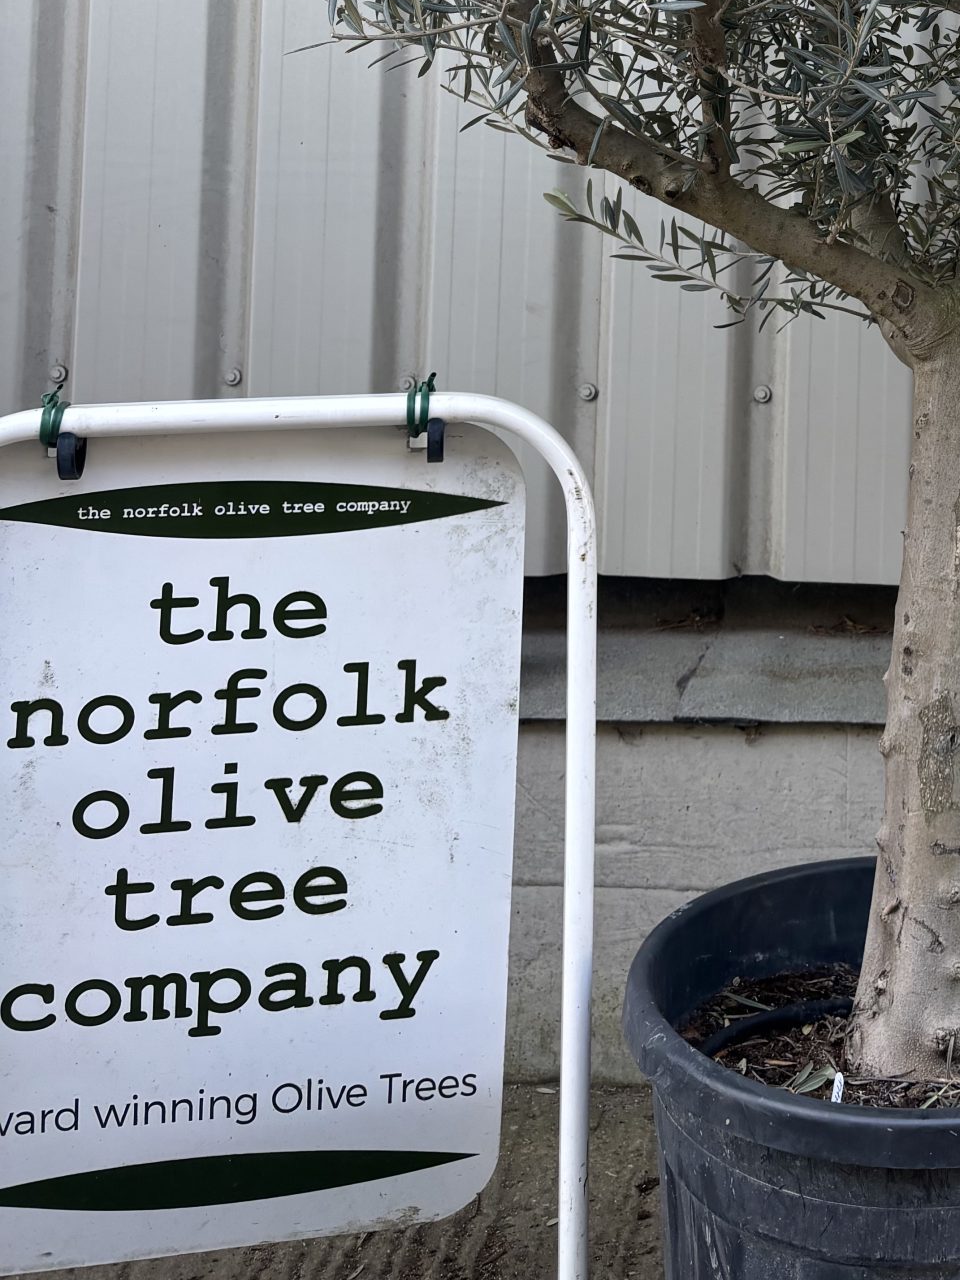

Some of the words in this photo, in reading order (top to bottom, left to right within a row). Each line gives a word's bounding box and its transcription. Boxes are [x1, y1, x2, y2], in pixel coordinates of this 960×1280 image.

[77, 503, 111, 520] the
[123, 503, 203, 519] norfolk
[214, 502, 270, 516] olive
[281, 502, 325, 514] tree
[335, 500, 412, 515] company
[150, 576, 328, 646] the
[7, 659, 450, 749] norfolk
[71, 762, 384, 840] olive
[105, 866, 348, 932] tree
[0, 949, 440, 1038] company
[93, 1089, 258, 1129] winning
[271, 1078, 368, 1114] Olive
[379, 1073, 477, 1105] Trees
